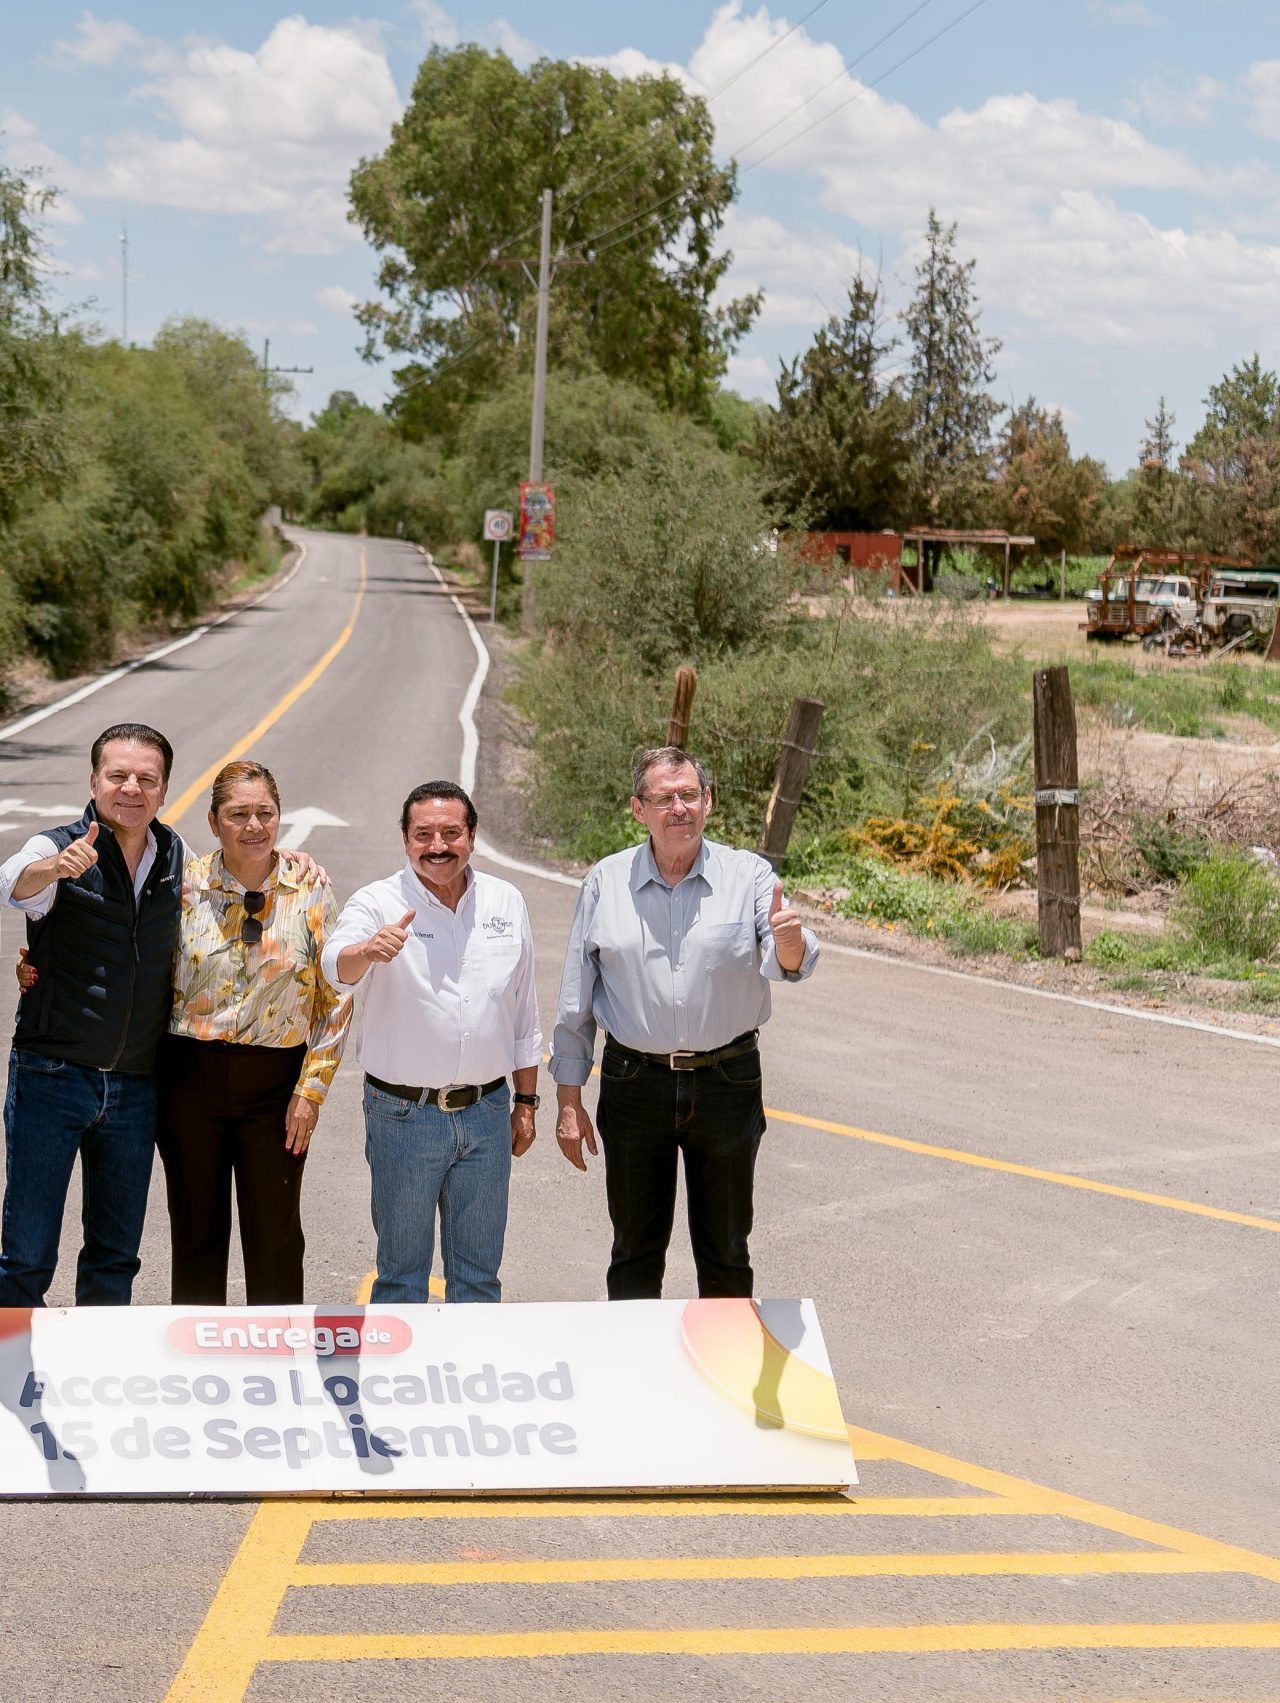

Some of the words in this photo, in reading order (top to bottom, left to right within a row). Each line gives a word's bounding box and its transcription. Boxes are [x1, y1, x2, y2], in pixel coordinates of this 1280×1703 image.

[194, 1321, 361, 1356] Entrega
[365, 1327, 392, 1344] de
[20, 1370, 231, 1408] Acceso
[242, 1375, 277, 1406] a
[289, 1361, 574, 1407] Localidad
[30, 1420, 98, 1461] 15
[110, 1416, 191, 1460] de
[203, 1414, 578, 1470] Septiembre
